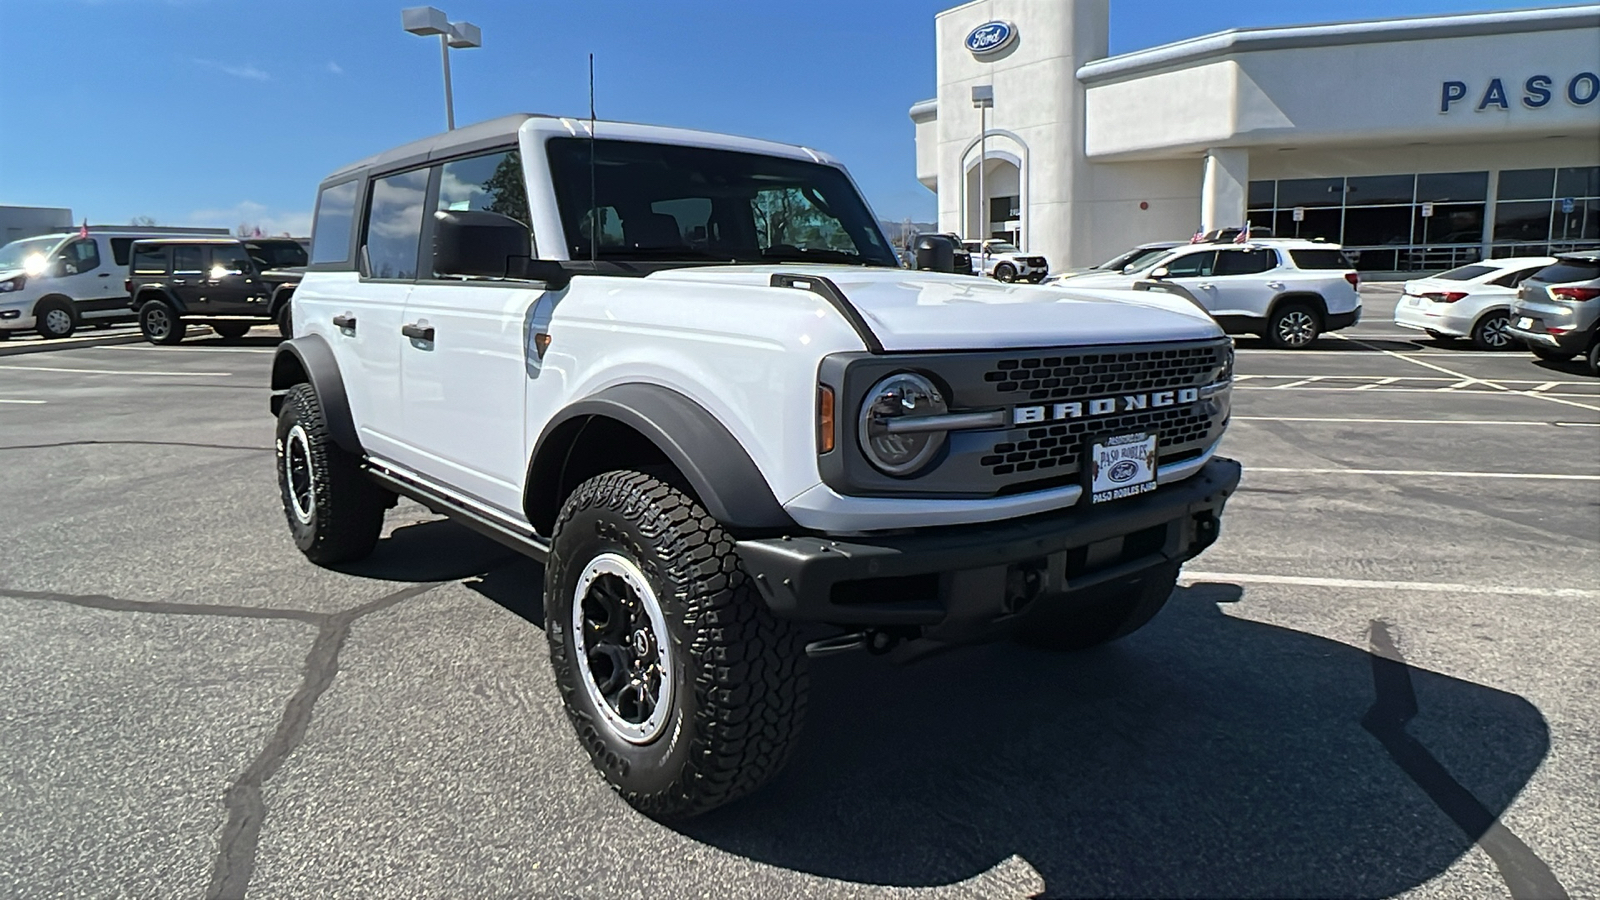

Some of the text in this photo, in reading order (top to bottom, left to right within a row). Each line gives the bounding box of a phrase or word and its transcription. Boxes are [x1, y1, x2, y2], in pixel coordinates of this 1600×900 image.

[971, 26, 1001, 48] Ford
[1440, 72, 1600, 113] PASO
[1013, 387, 1199, 424] BRONCO
[1100, 449, 1119, 469] PASO
[1093, 491, 1112, 504] PASO
